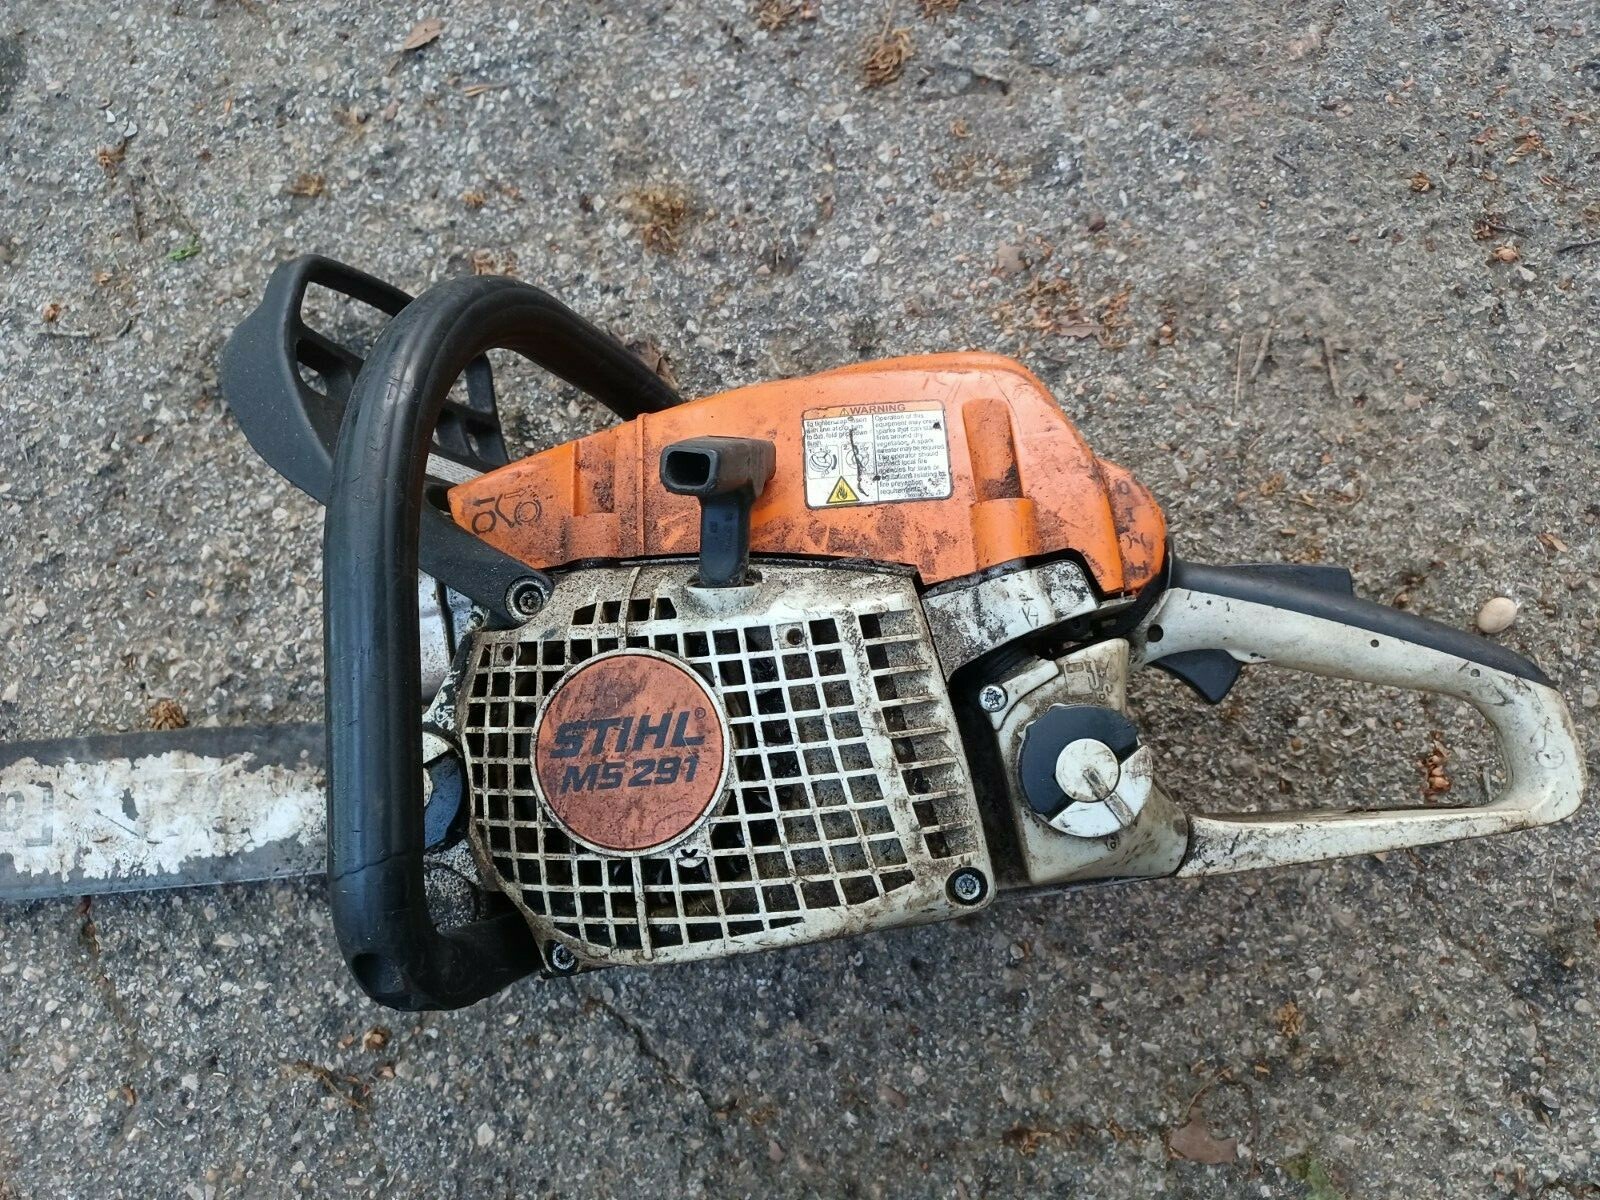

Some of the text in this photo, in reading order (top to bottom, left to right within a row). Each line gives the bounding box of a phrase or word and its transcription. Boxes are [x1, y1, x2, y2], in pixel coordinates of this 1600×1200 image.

[850, 404, 906, 415] WARNING
[550, 711, 705, 758] STIHL
[560, 752, 699, 793] MS 291
